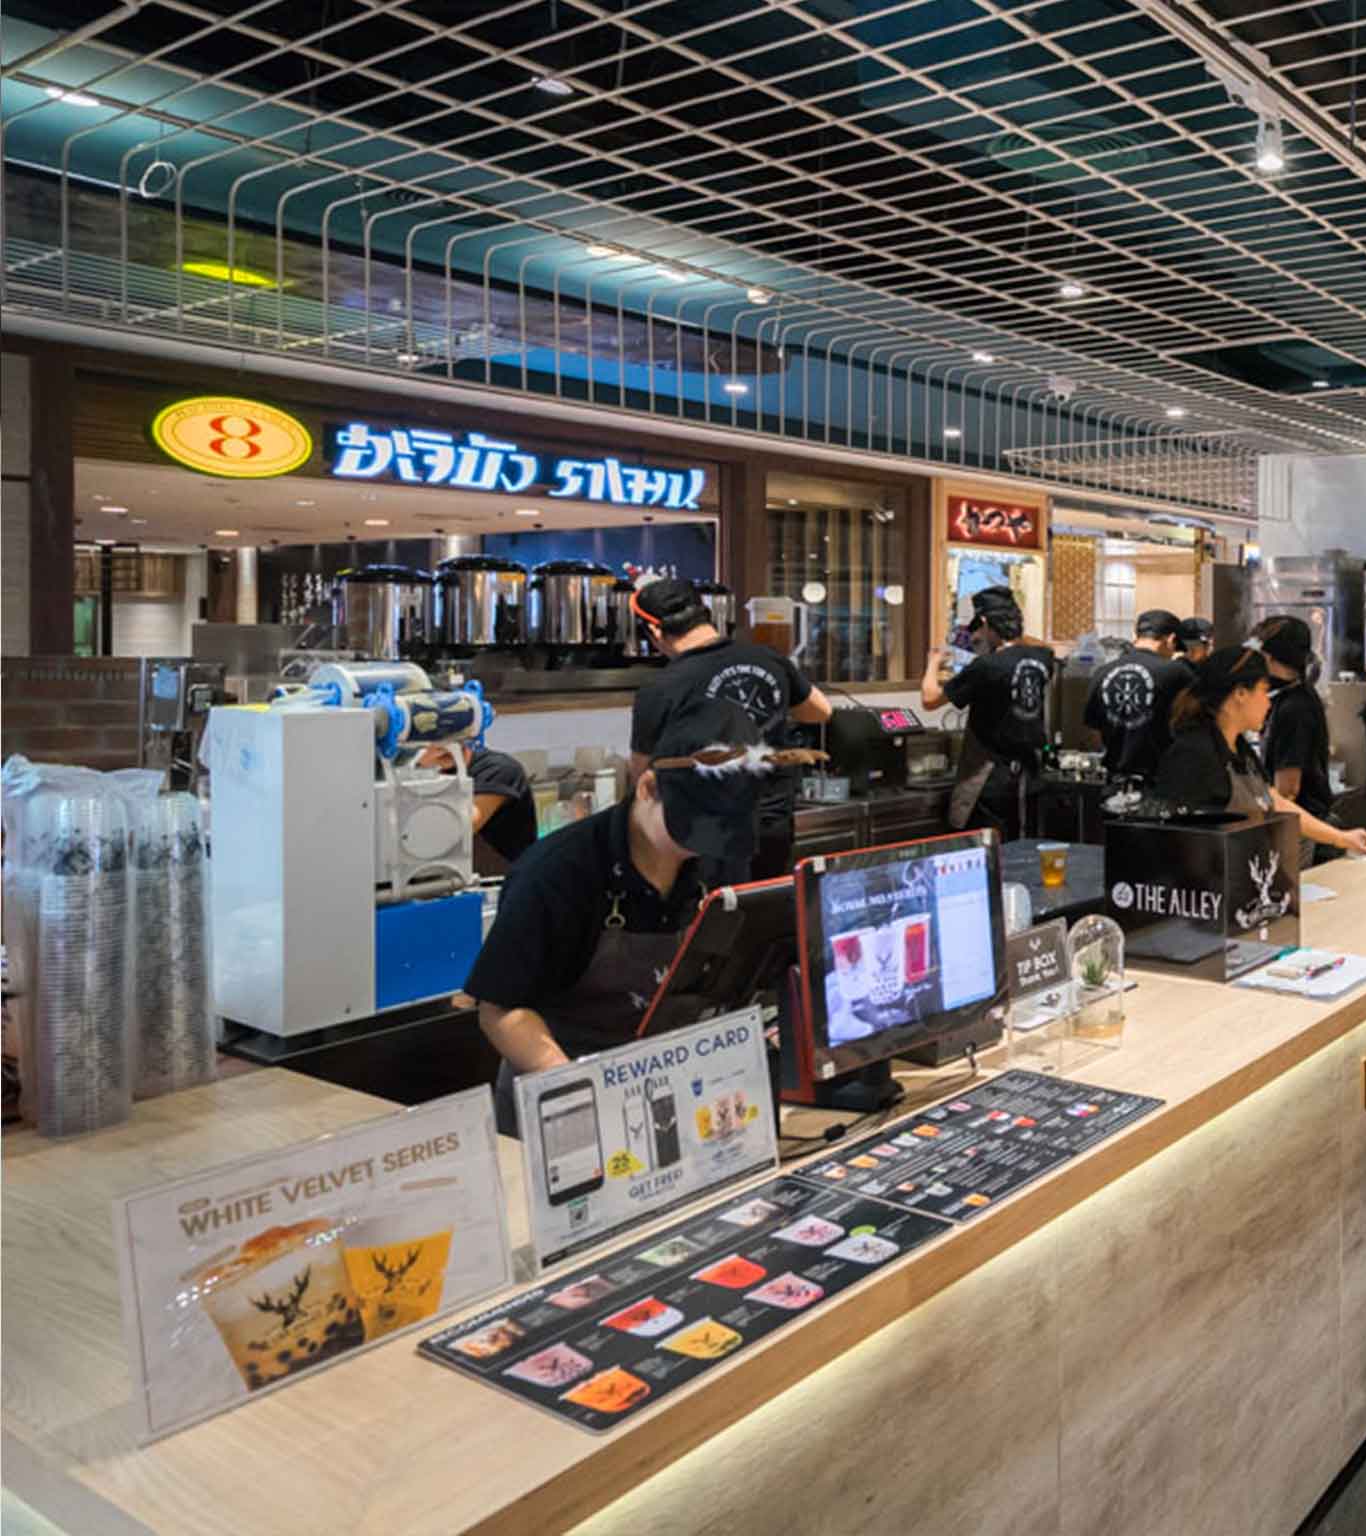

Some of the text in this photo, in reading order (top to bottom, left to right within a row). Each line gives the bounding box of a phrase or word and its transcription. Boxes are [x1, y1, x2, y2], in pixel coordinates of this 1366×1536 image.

[208, 415, 262, 459] 8
[1134, 883, 1166, 914] THE
[1168, 887, 1223, 921] ALLEY
[1033, 950, 1057, 970] BOX
[603, 1025, 750, 1089] REWARD CARD
[179, 1191, 273, 1238] WHITE
[281, 1157, 376, 1204] VELVET
[382, 1131, 461, 1173] SERIES
